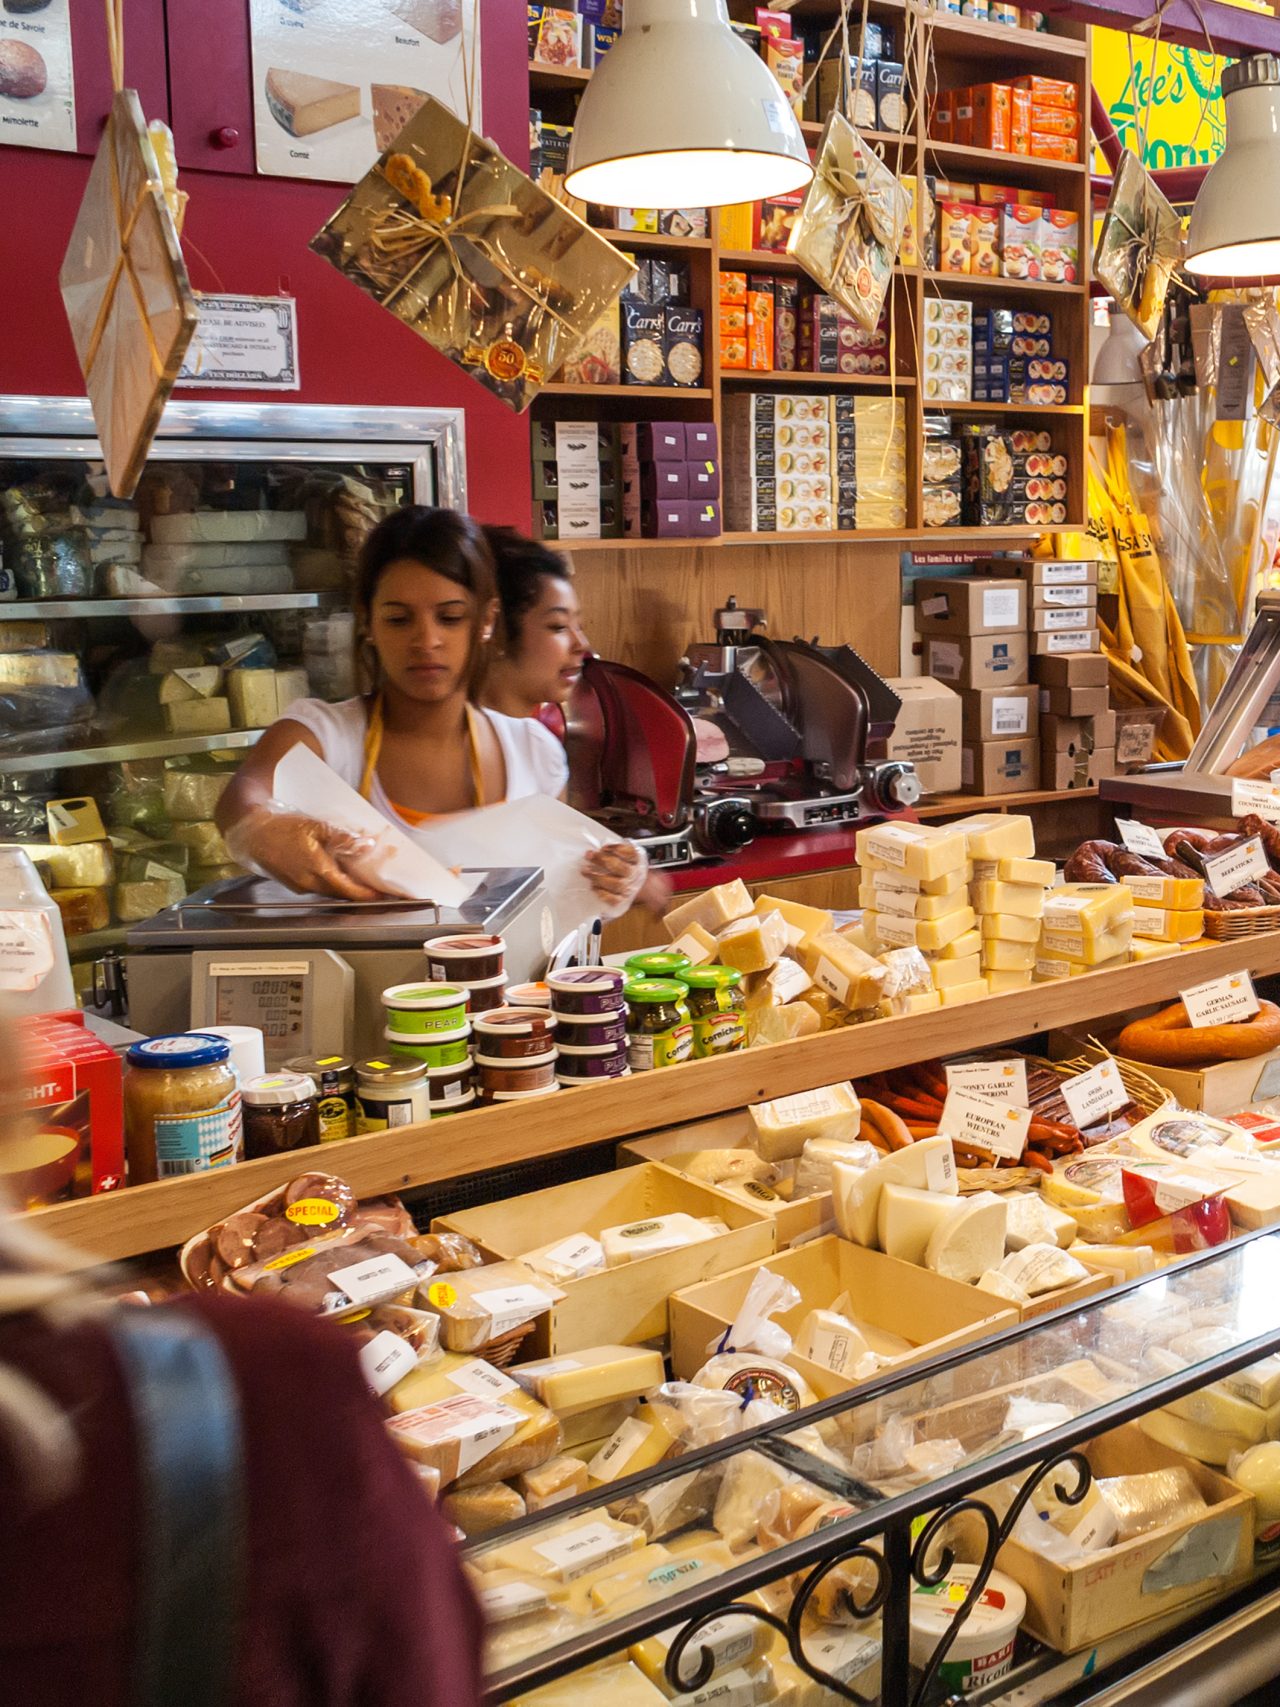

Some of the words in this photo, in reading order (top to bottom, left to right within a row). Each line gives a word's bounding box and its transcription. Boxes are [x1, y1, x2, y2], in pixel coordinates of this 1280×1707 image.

[9, 20, 19, 29] de
[20, 22, 45, 33] Savoie
[395, 36, 420, 47] Beaufort
[2, 116, 39, 128] Mimolette
[627, 307, 664, 331] Carr's
[668, 315, 702, 333] Carr's
[914, 556, 925, 564] Les
[927, 554, 953, 563] familles
[954, 554, 963, 562] de
[1221, 867, 1235, 877] BEER
[1235, 858, 1253, 869] STICKS
[1195, 1005, 1219, 1018] GARLIC
[1220, 996, 1248, 1010] SAUSAGE
[1206, 993, 1233, 1007] GERMAN
[425, 1018, 459, 1030] PEAR
[987, 1081, 1016, 1090] GARLIC
[965, 1111, 1006, 1131] EUROPEAN
[967, 1121, 1000, 1138] WIENERS
[288, 1205, 335, 1218] SPECIAL
[265, 1251, 315, 1270] SPECIAL
